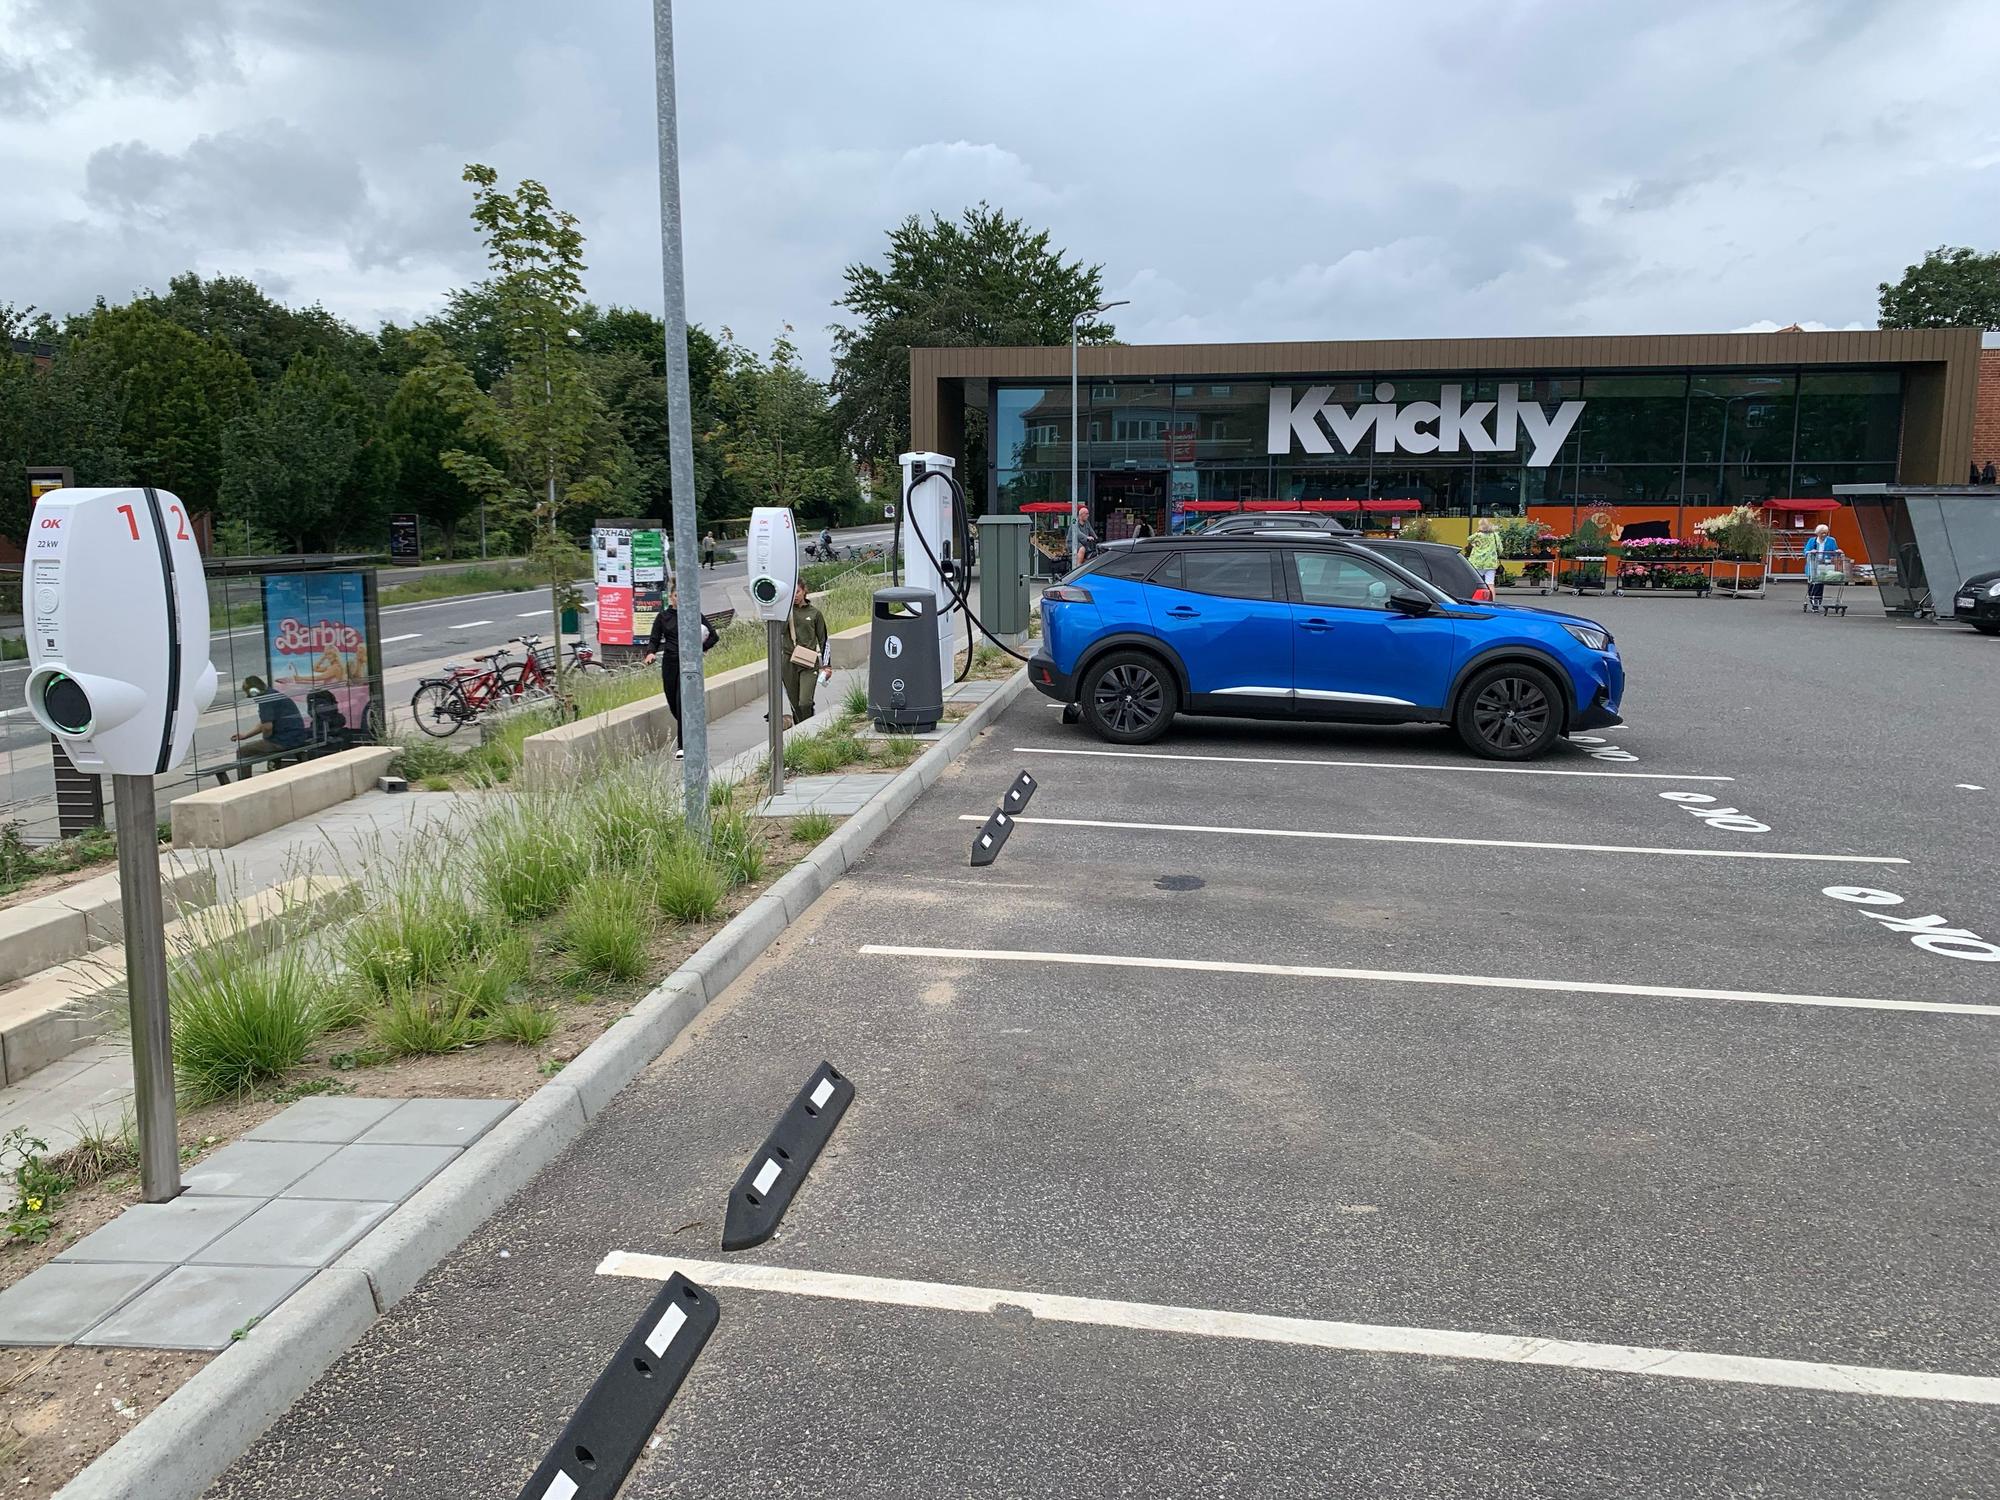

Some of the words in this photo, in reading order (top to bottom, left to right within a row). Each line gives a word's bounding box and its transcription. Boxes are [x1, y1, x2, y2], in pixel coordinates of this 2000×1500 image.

[1268, 382, 1587, 467] Kvickly
[40, 519, 62, 529] OK
[117, 505, 140, 540] 1
[170, 505, 189, 540] 2
[783, 514, 791, 529] 3
[37, 540, 46, 548] 22
[46, 540, 59, 548] kW
[276, 618, 359, 650] Barbie
[1677, 804, 1772, 833] OK
[1858, 909, 2000, 962] OK
